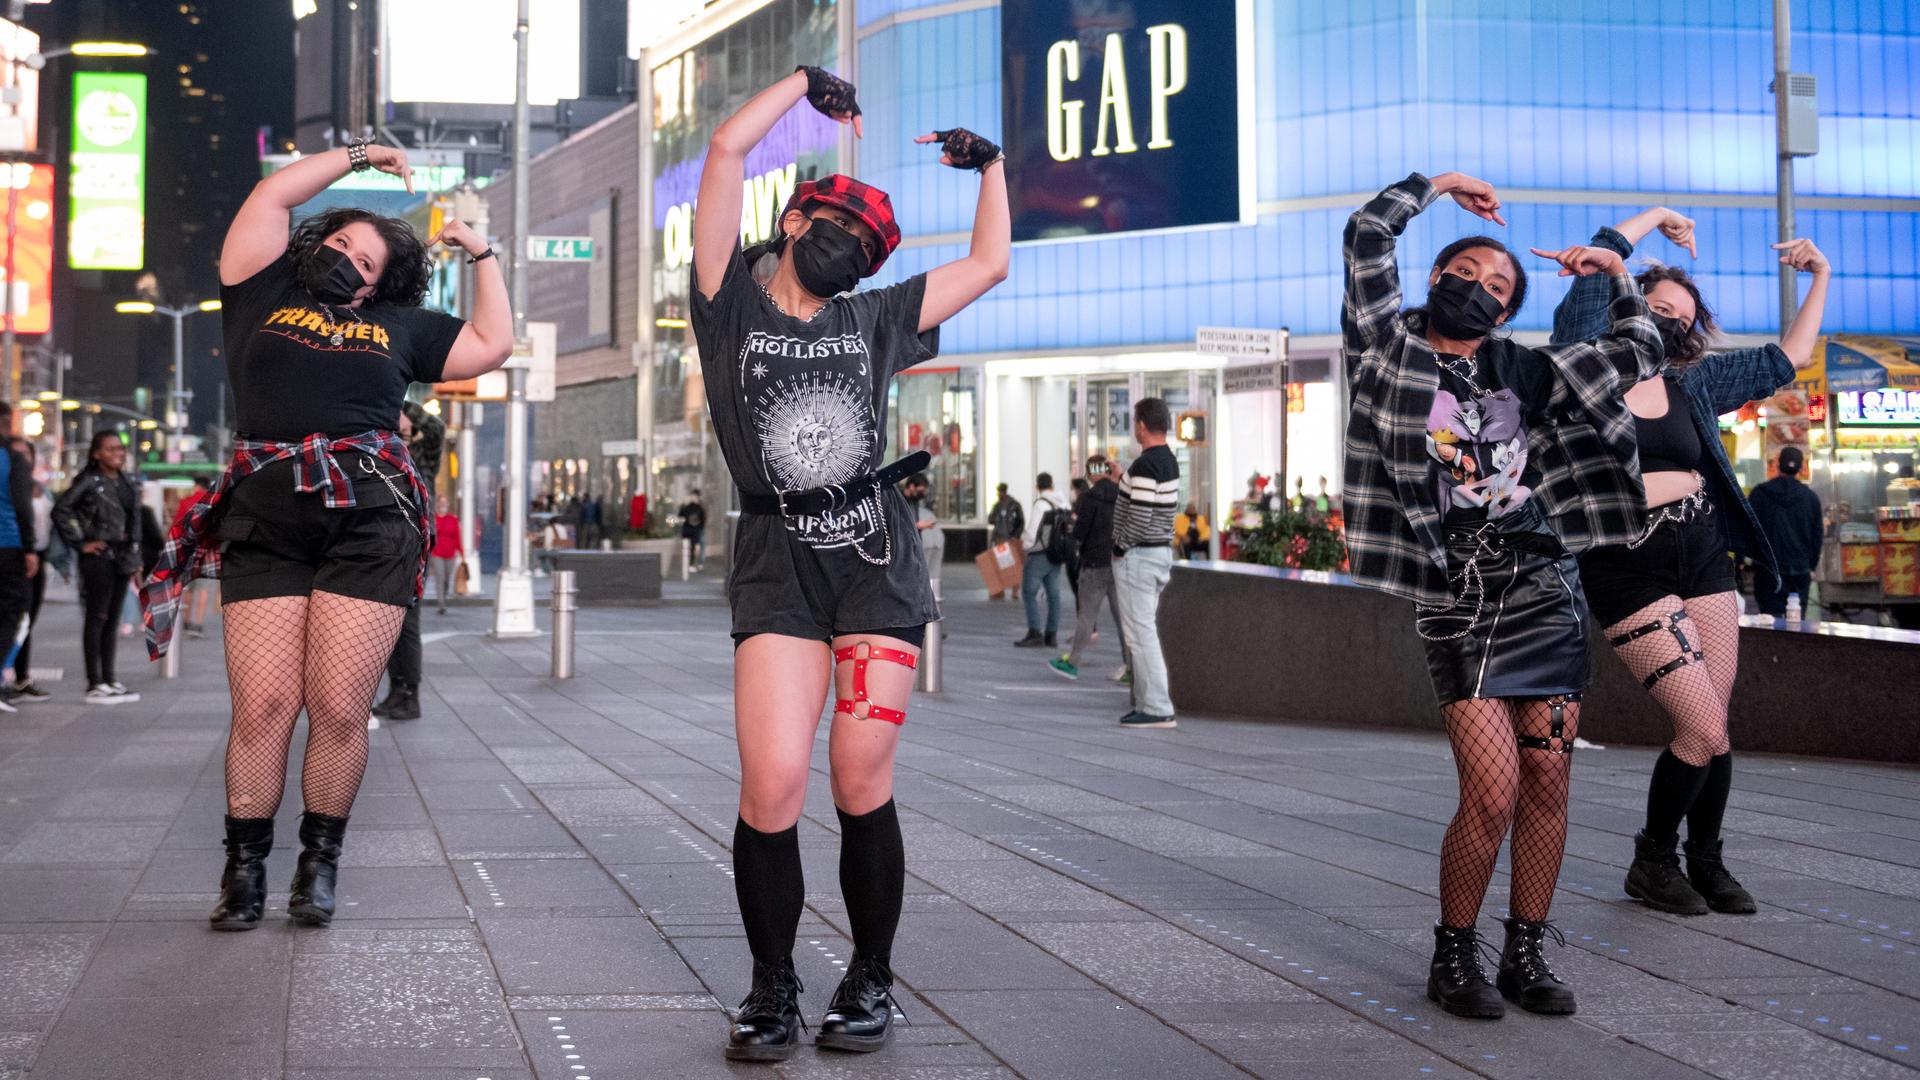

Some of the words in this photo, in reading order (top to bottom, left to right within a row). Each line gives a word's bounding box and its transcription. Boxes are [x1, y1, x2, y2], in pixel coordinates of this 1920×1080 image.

[1047, 23, 1188, 162] GAP
[664, 198, 698, 270] OL
[741, 162, 798, 247] AVY
[552, 239, 575, 258] 44
[1200, 331, 1237, 342] PEDESTRIAN
[1238, 332, 1254, 343] FLOW
[751, 338, 865, 359] HOLLISTER
[1200, 343, 1215, 352] KEEP
[1217, 344, 1240, 354] MOVING
